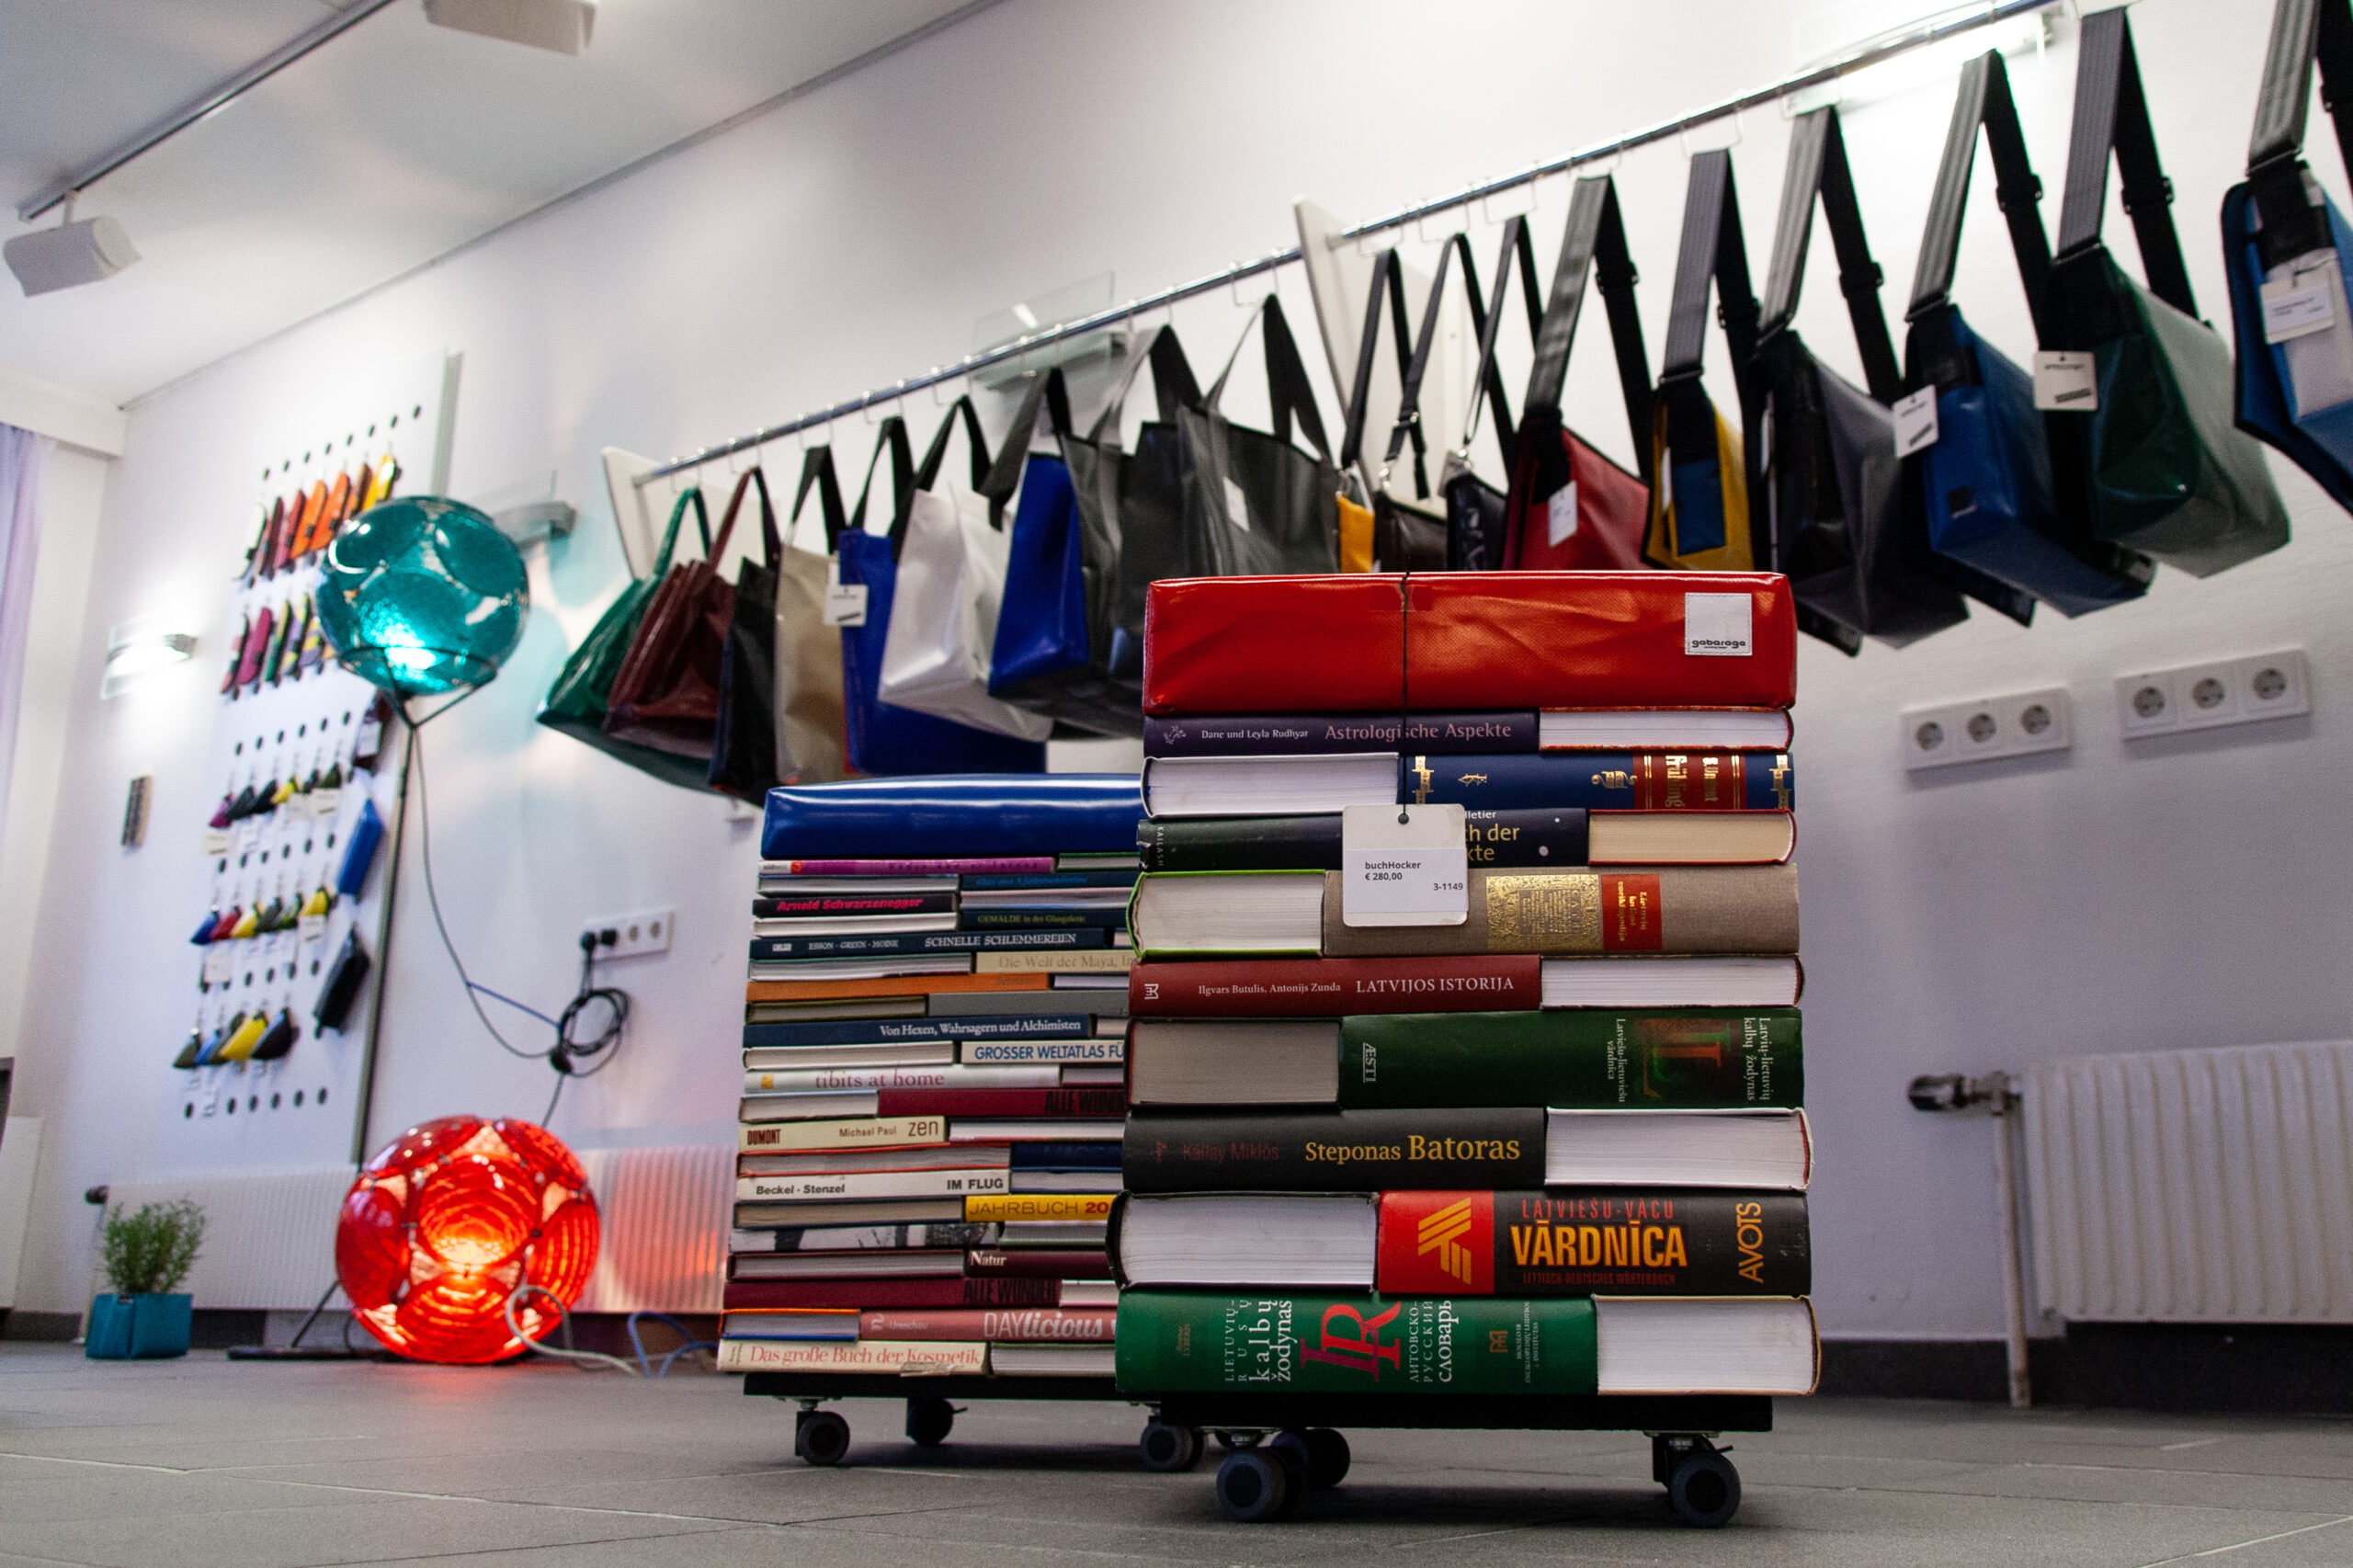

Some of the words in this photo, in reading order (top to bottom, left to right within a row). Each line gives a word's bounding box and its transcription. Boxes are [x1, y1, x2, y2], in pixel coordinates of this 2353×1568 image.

[1692, 640, 1745, 649] gabaraga
[1201, 729, 1223, 739] Dane
[1226, 729, 1244, 738] und
[1247, 728, 1269, 740] Leyla
[1273, 728, 1308, 740] Rudhyar
[1325, 724, 1438, 743] Astrologische
[1445, 723, 1511, 741] Aspekte
[1487, 823, 1519, 841] der
[1365, 861, 1421, 870] buchHocker
[1372, 873, 1403, 881] 280,00
[1433, 883, 1463, 892] 3-1149
[778, 900, 820, 912] Arnold
[823, 898, 924, 910] Schwarzenegger
[925, 936, 981, 948] SCHNELLE
[983, 934, 1077, 946] SCHLEMMEREIEN
[998, 956, 1020, 968] Die
[1025, 955, 1052, 968] Welt
[1057, 955, 1077, 968] der
[1081, 955, 1118, 971] Maya,
[1199, 984, 1230, 996] Ilgvars
[1233, 983, 1267, 995] Butulis,
[1268, 983, 1309, 996] Antonijs
[1311, 983, 1341, 993] Zunda
[1357, 979, 1436, 994] LATVIJOS
[1440, 977, 1515, 993] ISTORIJA
[880, 1025, 900, 1036] Von
[902, 1024, 938, 1037] Hexen,
[939, 1021, 997, 1036] Wahrsagern
[999, 1020, 1019, 1032] und
[1020, 1019, 1081, 1032] Alchimisten
[975, 1046, 1033, 1060] GROSSER
[1037, 1045, 1105, 1059] WELTATLAS
[816, 1071, 862, 1088] tibits
[868, 1074, 885, 1086] at
[893, 1069, 945, 1086] home
[1744, 1055, 1758, 1101] žodynas
[747, 1129, 780, 1145] DUMONT
[839, 1127, 874, 1138] Michael
[877, 1125, 897, 1136] Paul
[908, 1120, 938, 1137] zen
[1305, 1142, 1401, 1165] Steponas
[1408, 1135, 1520, 1161] Batoras
[756, 1185, 794, 1195] Beckel
[803, 1184, 846, 1194] Stenzel
[947, 1180, 962, 1190] IM
[968, 1178, 1004, 1189] FLUG
[969, 1201, 1079, 1216] JAHRBUCH
[1522, 1198, 1674, 1219] LATVIEŠU-VĀCU
[1510, 1220, 1688, 1267] VĀRDNĪCA
[1735, 1201, 1764, 1283] AVOTS
[970, 1251, 1006, 1267] Natur
[964, 1278, 994, 1302] ALLE
[996, 1278, 1057, 1301] WUNDER
[983, 1312, 1103, 1338] DAYlicious
[1270, 1300, 1298, 1382] žodynas
[1424, 1301, 1433, 1382] РУССКИЙ
[1438, 1300, 1459, 1382] словарь
[750, 1347, 779, 1362] Das
[782, 1346, 828, 1365] große
[833, 1347, 872, 1363] Buch
[877, 1348, 905, 1363] der
[906, 1347, 980, 1365] Kosmetik
